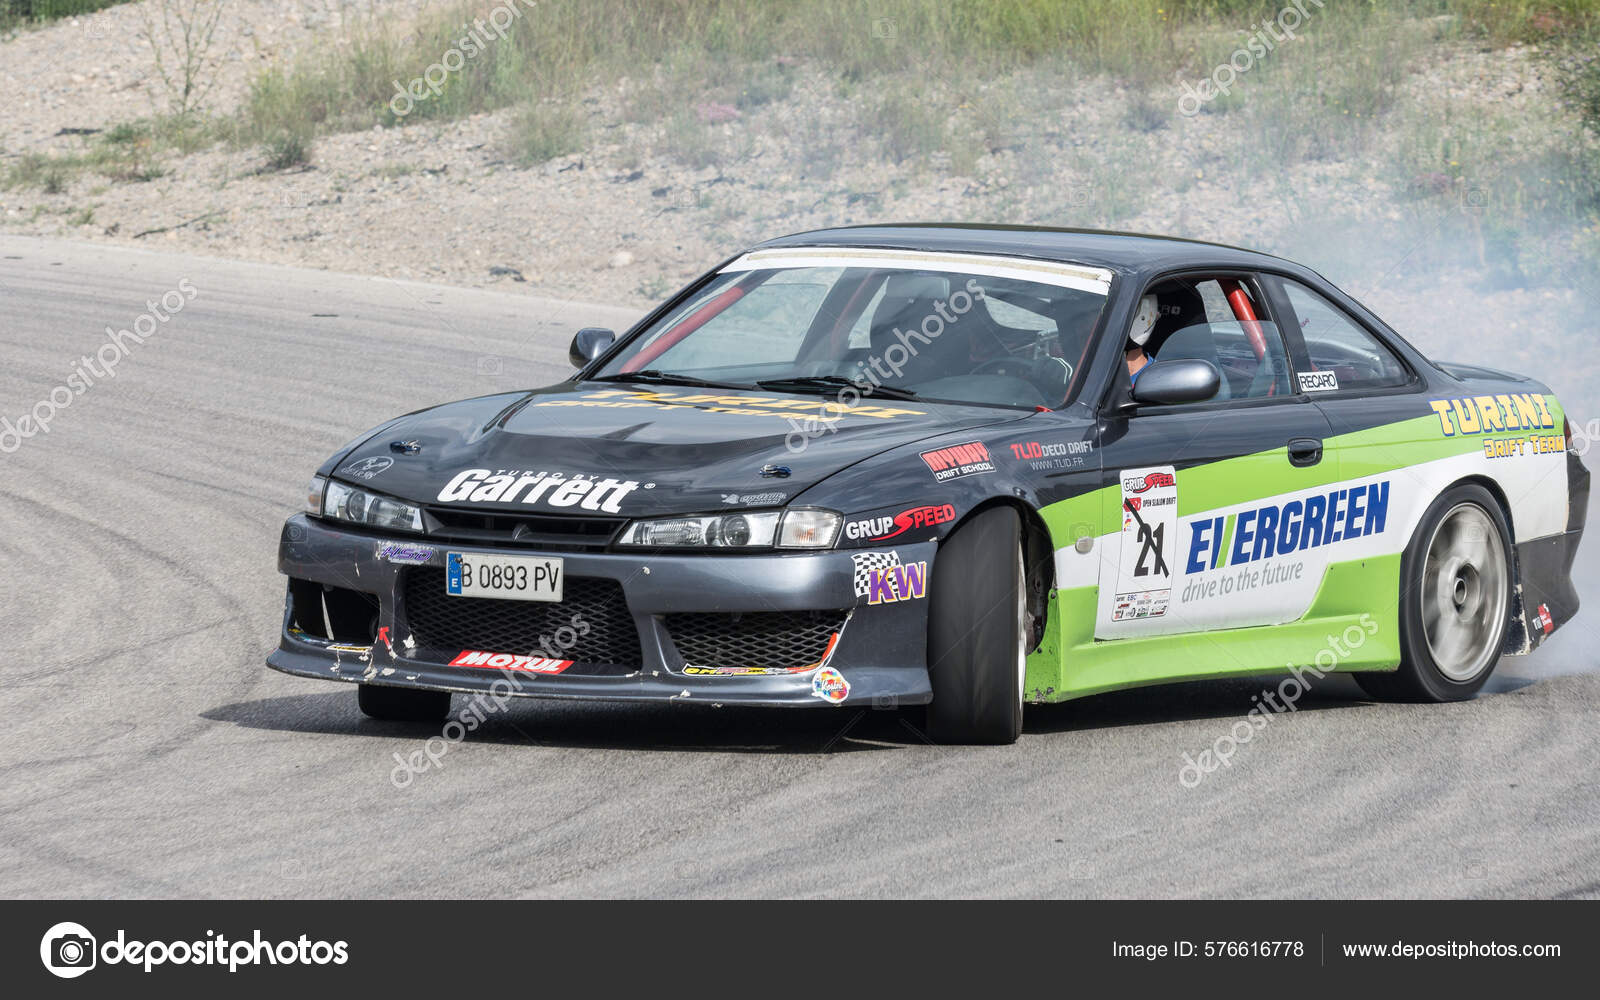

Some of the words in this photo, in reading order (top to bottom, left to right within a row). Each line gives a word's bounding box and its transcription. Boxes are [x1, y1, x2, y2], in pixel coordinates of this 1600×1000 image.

[1299, 373, 1336, 389] RECARO
[1429, 393, 1554, 437] TURINI
[1069, 440, 1094, 454] DRIFT
[496, 469, 563, 479] TURBO
[573, 474, 600, 482] BY
[936, 468, 960, 481] DRIFT
[961, 462, 994, 474] SCHOOL
[1029, 457, 1085, 471] WWW.TLID.FR
[436, 469, 639, 514] Garrett
[1185, 480, 1390, 575] EVERGREEN
[1134, 522, 1165, 577] 21
[451, 578, 459, 588] E
[461, 563, 473, 587] B
[479, 564, 528, 591] 0893
[534, 565, 559, 592] PV
[868, 561, 927, 605] KW
[1182, 577, 1216, 603] drive
[1219, 574, 1234, 597] to
[1236, 566, 1259, 591] the
[1261, 561, 1304, 591] future
[455, 651, 564, 672] MOTUL
